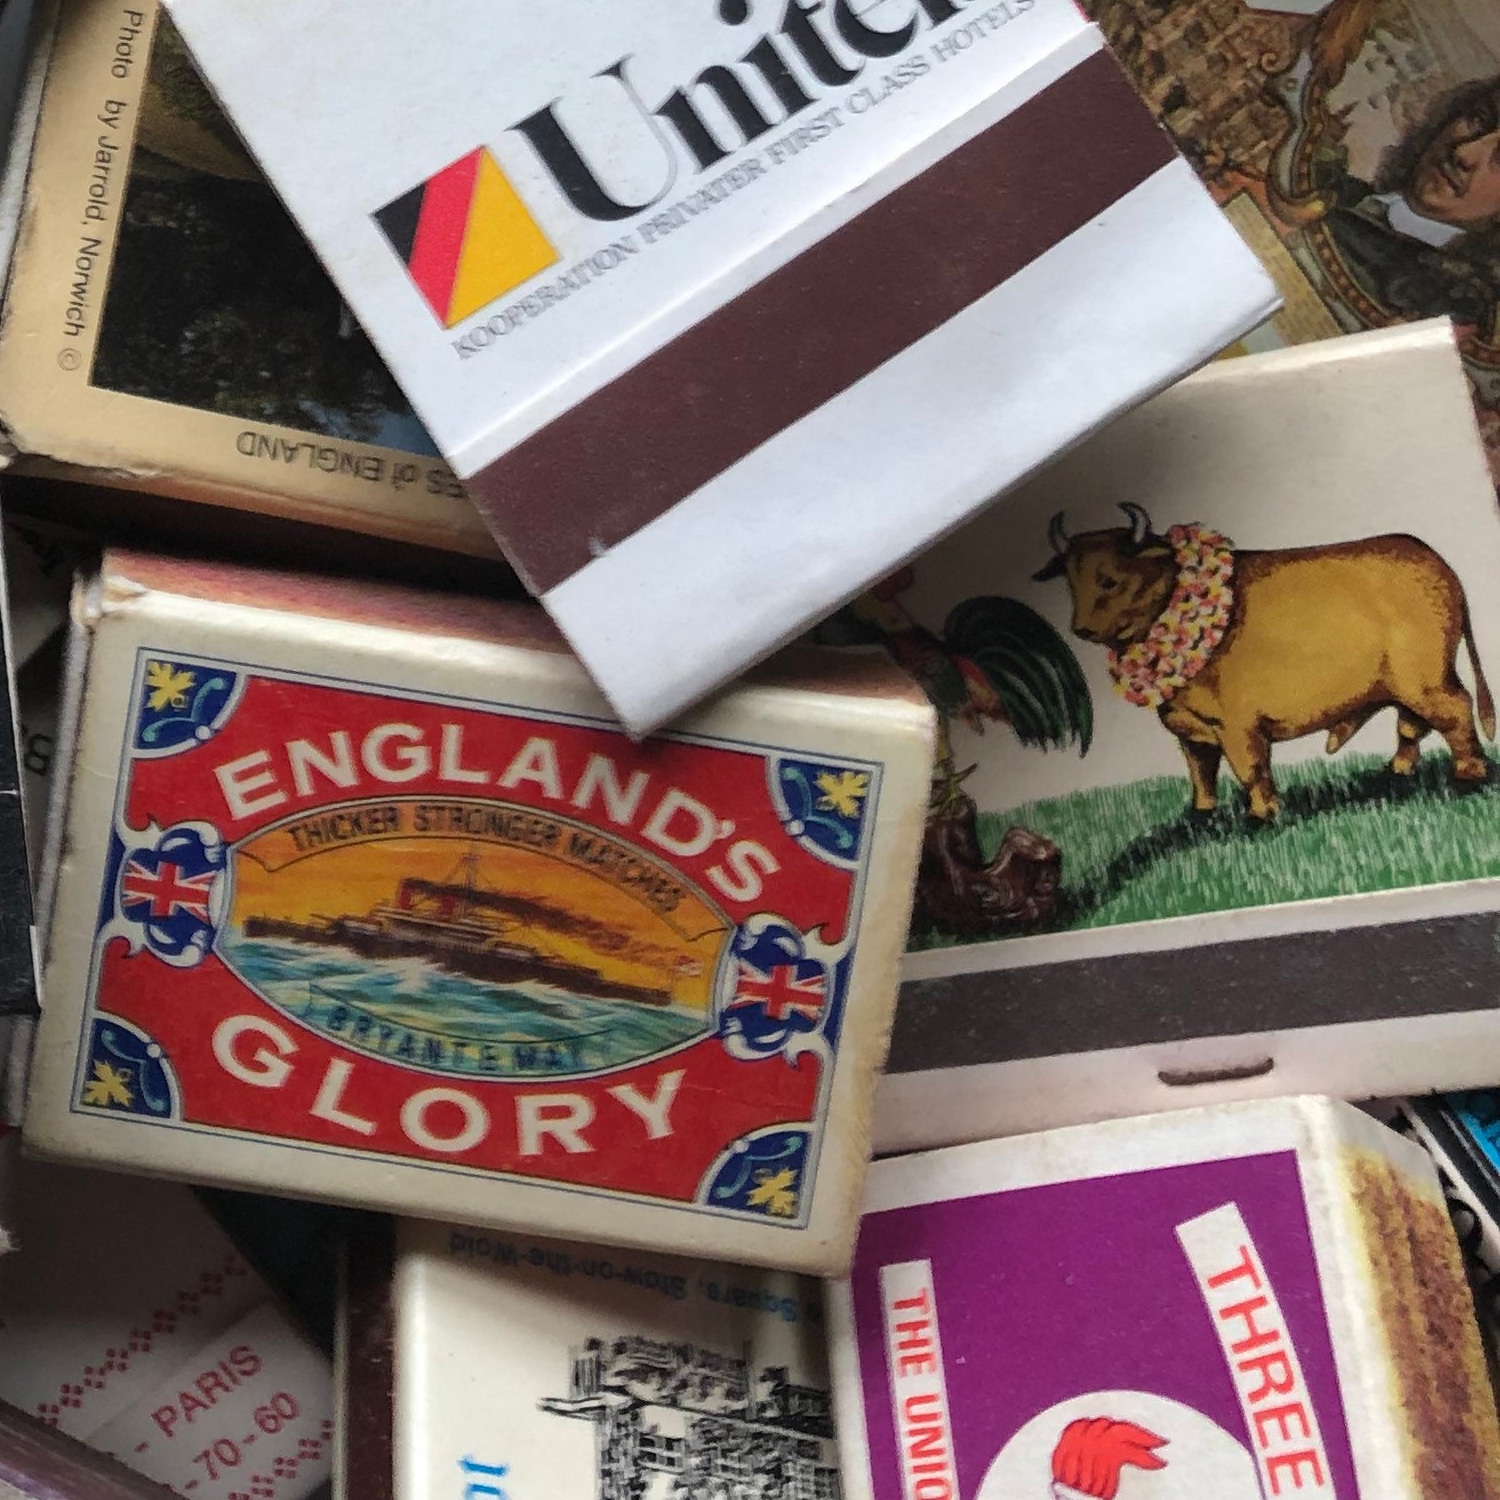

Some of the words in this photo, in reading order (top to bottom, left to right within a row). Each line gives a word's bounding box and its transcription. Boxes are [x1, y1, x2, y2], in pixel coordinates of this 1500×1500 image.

[111, 8, 146, 80] Photo
[97, 97, 127, 132] by
[81, 131, 121, 226] Jarrold,
[450, 236, 640, 361] KOOPERATION
[637, 153, 769, 245] PRIVATER
[766, 106, 847, 170] FIRST
[846, 55, 932, 120] CLASS
[64, 234, 102, 338] Norwich
[235, 430, 380, 483] ENGLAND
[214, 723, 781, 902] ENGLAND'S
[292, 804, 399, 852] THICKER
[413, 802, 559, 849] STRONGER
[567, 827, 683, 914] MATCHES
[211, 1012, 687, 1157] GLORY
[891, 1288, 939, 1378] THE
[1207, 1243, 1326, 1497] THREE
[151, 1345, 263, 1438] PARIS
